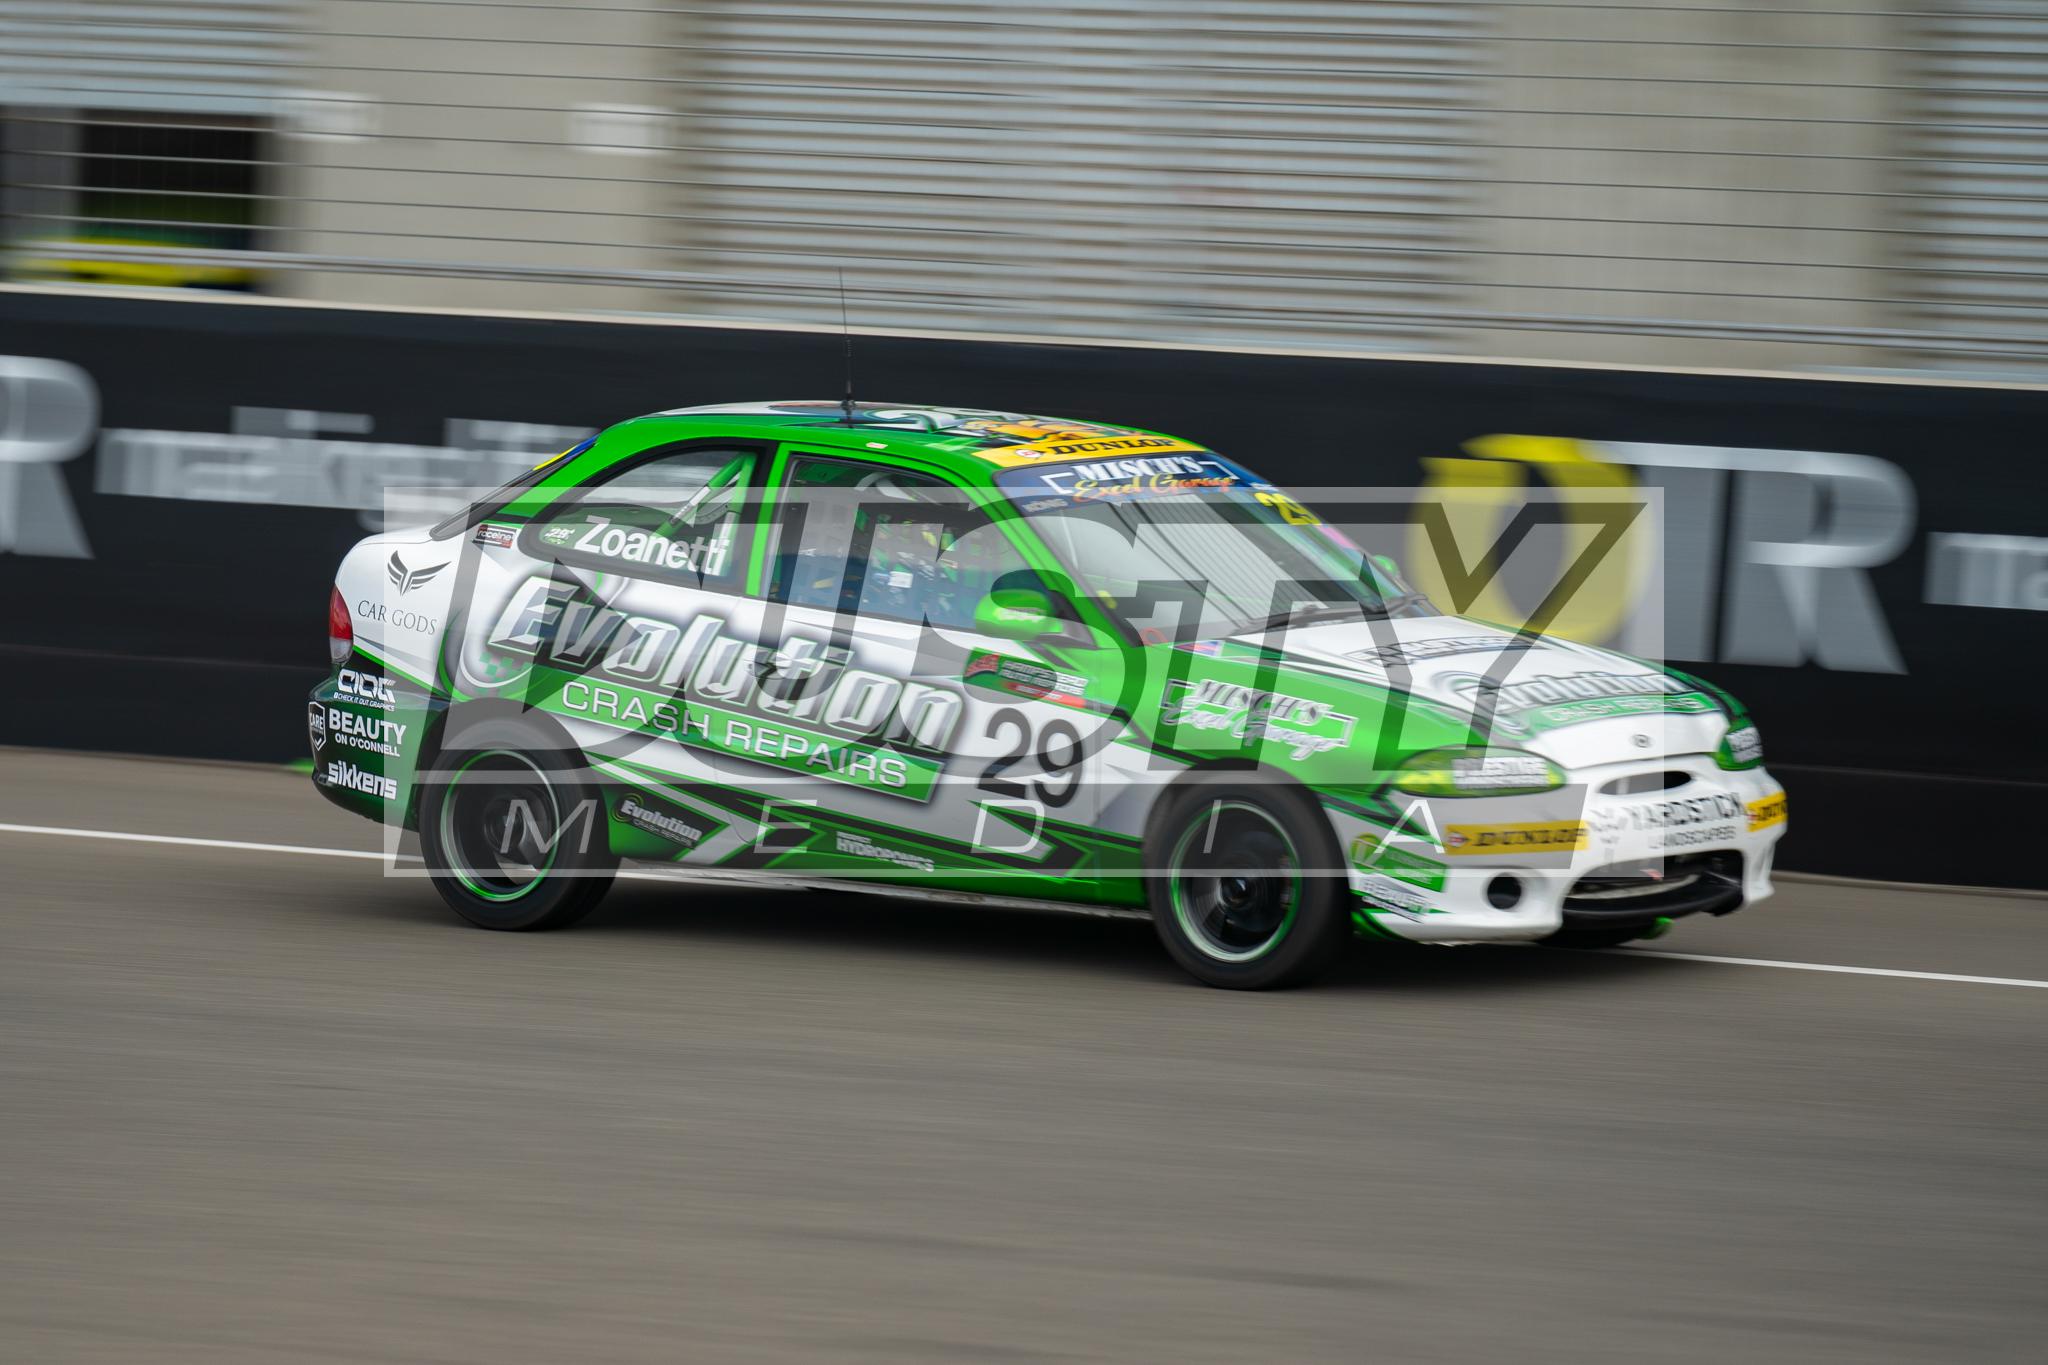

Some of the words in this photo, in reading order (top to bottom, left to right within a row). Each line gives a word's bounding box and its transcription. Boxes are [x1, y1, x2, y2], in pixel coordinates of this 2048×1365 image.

[1050, 438, 1177, 456] DUNLOP
[1071, 456, 1204, 482] MISCH'S
[573, 514, 730, 577] Zoanetti
[357, 600, 387, 622] CAR
[391, 608, 438, 636] GODS
[486, 575, 963, 753] Evolution
[329, 707, 407, 745] BEAUTY
[335, 733, 348, 745] ON
[349, 736, 400, 757] O'CONNELL
[562, 681, 711, 741] CRASH
[724, 719, 908, 789] REPAIRS
[976, 707, 1084, 808] 29
[327, 760, 398, 800] sikkens
[621, 800, 703, 841] Evolution
